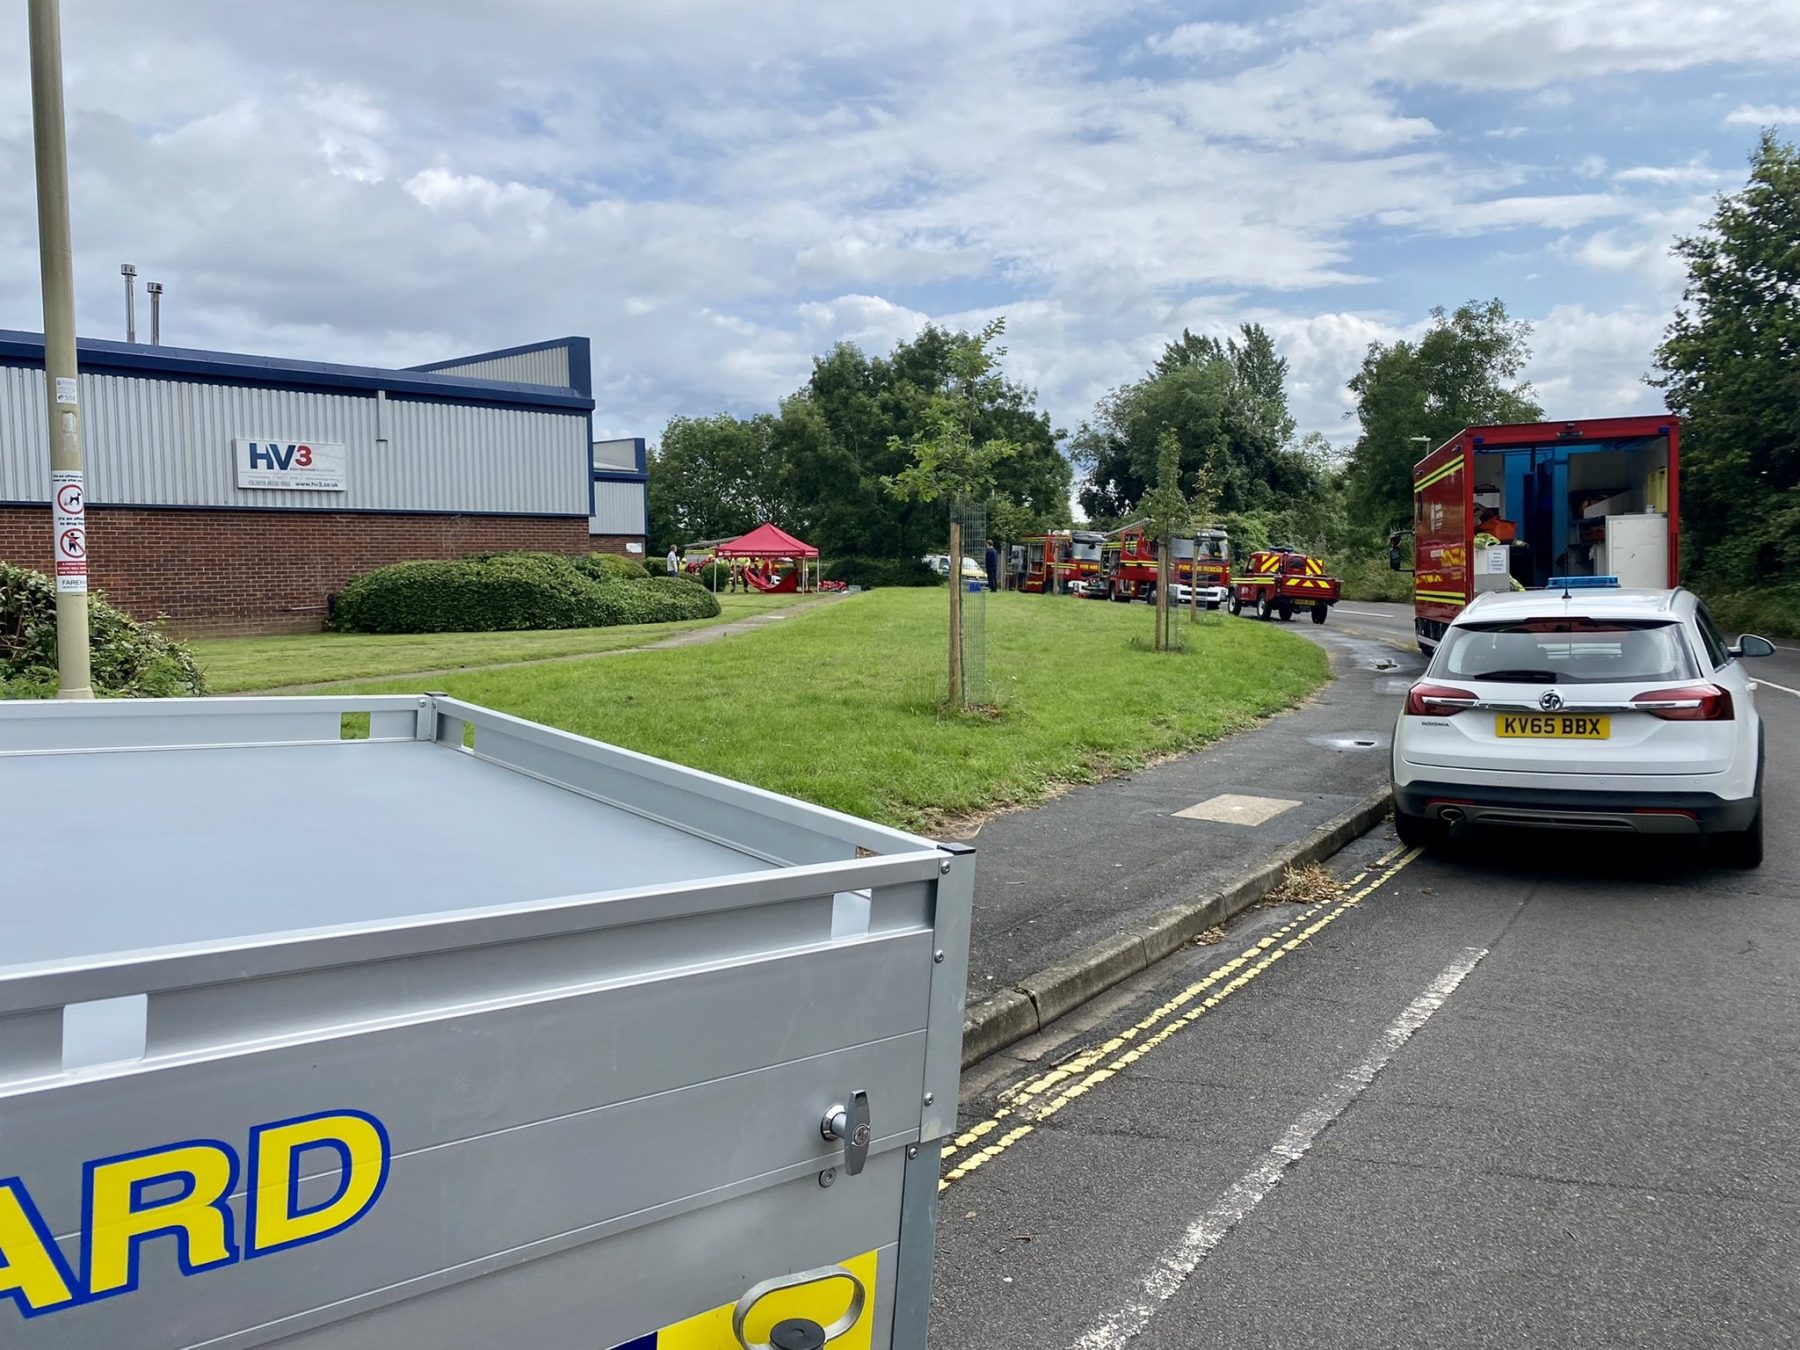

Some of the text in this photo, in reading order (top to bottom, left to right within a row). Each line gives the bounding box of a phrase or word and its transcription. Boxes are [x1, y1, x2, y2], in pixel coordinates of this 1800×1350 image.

[249, 442, 313, 471] HV3
[1504, 717, 1601, 735] KV65 BBX
